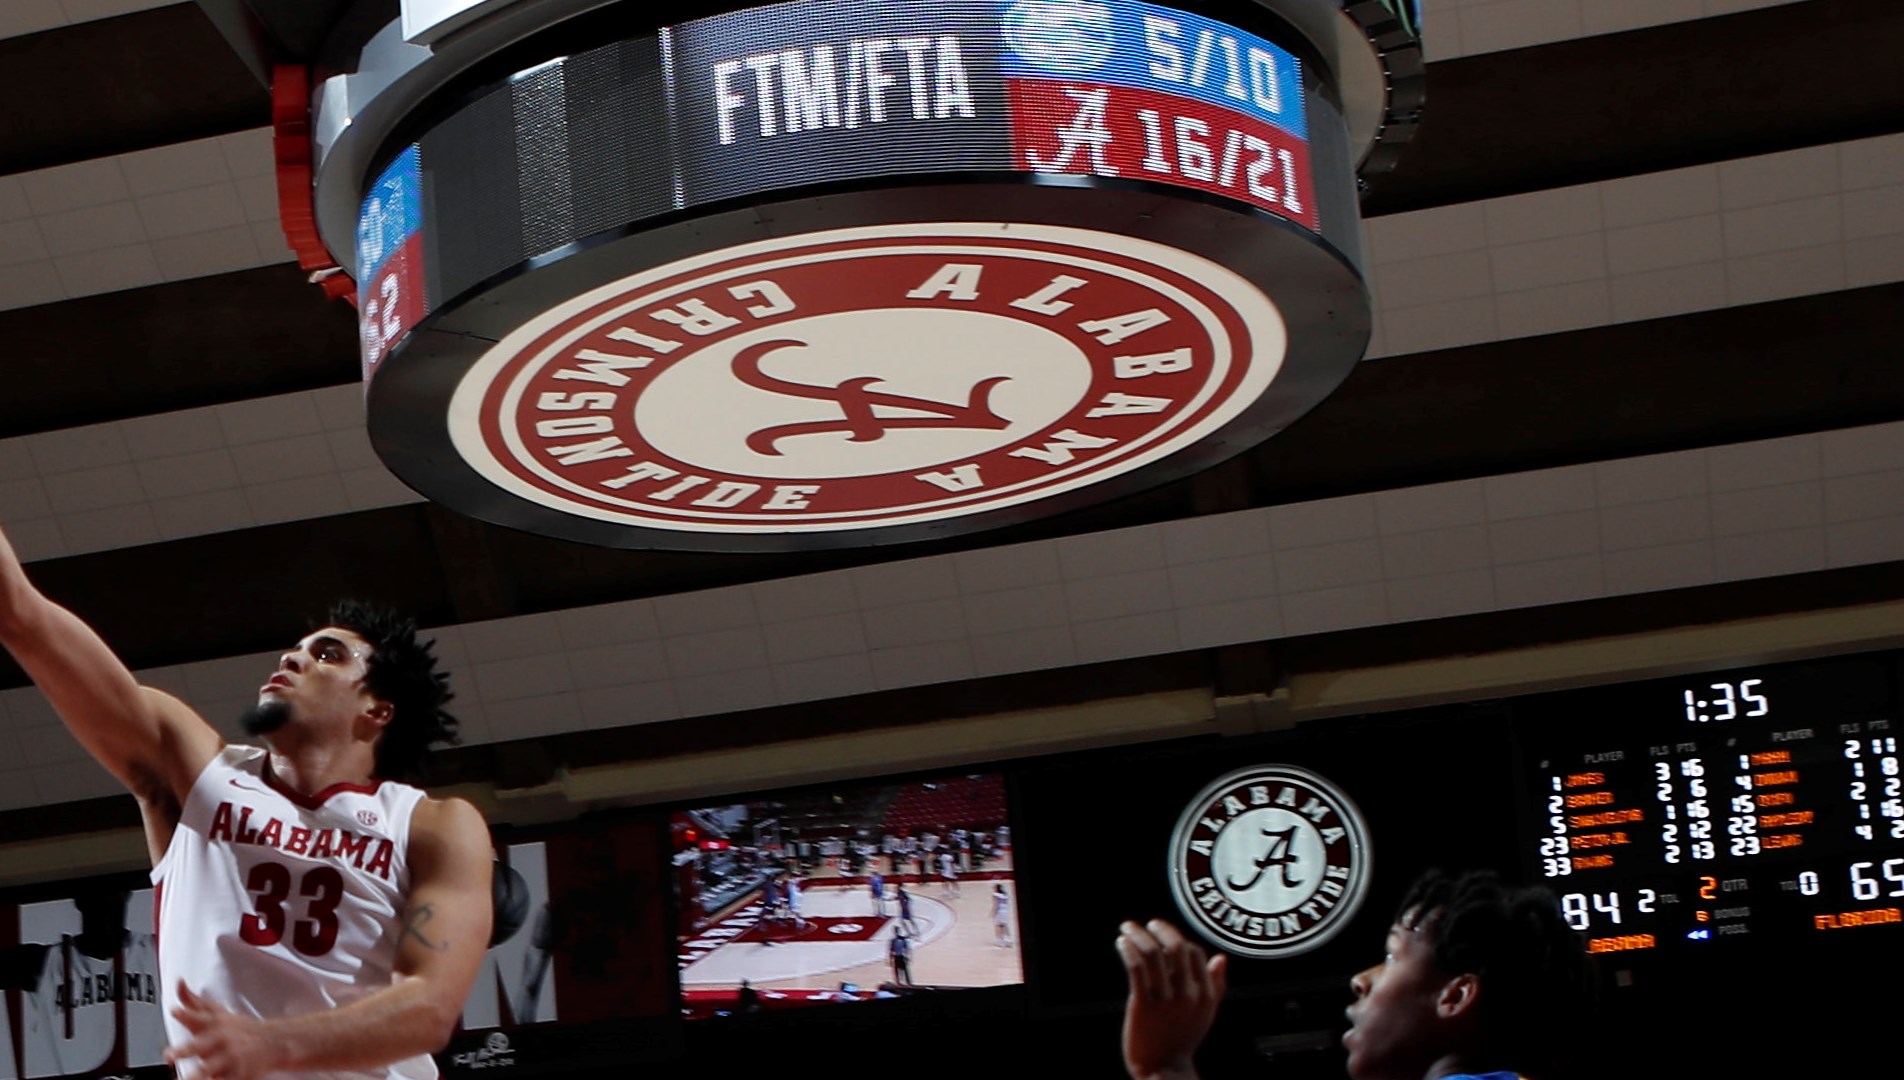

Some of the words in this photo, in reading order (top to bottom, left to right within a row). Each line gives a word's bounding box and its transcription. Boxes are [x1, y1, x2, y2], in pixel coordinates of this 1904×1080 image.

[1144, 15, 1281, 115] 5/10
[713, 35, 976, 146] FTM/FTA
[1137, 109, 1303, 214] 16/21
[534, 278, 798, 466] CRIMSON
[905, 263, 1194, 493] ALABAMA
[607, 459, 820, 511] TIDE
[1684, 678, 1769, 722] 1:35
[1739, 754, 1750, 770] 1
[1844, 739, 1861, 759] 2
[1871, 737, 1896, 755] 11
[1772, 728, 1814, 742] PLAYER
[1552, 776, 1562, 791] 1
[1655, 762, 1671, 781] 3
[1680, 758, 1705, 777] 16
[1584, 751, 1625, 765] PLAYER
[1735, 775, 1753, 791] 4
[1854, 762, 1864, 778] 1
[1881, 756, 1899, 776] 8
[1548, 795, 1564, 814] 2
[1657, 782, 1673, 801] 2
[1689, 778, 1708, 798] 6
[1731, 794, 1756, 813] 15
[1850, 781, 1867, 800] 2
[1884, 777, 1901, 797] 2
[1190, 785, 1346, 857] ALABAMA
[1550, 815, 1567, 835] 5
[1666, 804, 1676, 820] 1
[1686, 799, 1710, 818] 16
[1728, 815, 1757, 835] 22
[1859, 803, 1870, 819] 1
[209, 801, 394, 881] ALABAMA
[1540, 836, 1570, 857] 23
[1662, 823, 1678, 843] 2
[1688, 820, 1712, 839] 12
[1730, 836, 1761, 857] 23
[1854, 824, 1873, 841] 4
[1543, 857, 1572, 877] 33
[1665, 844, 1681, 864] 2
[1691, 841, 1716, 860] 13
[1299, 864, 1351, 921] TIDE
[1699, 875, 1717, 900] 2
[1798, 871, 1821, 896] 0
[239, 861, 344, 957] 33
[1191, 876, 1302, 937] CRIMSON
[1561, 891, 1622, 931] 84
[1637, 888, 1656, 913] 2
